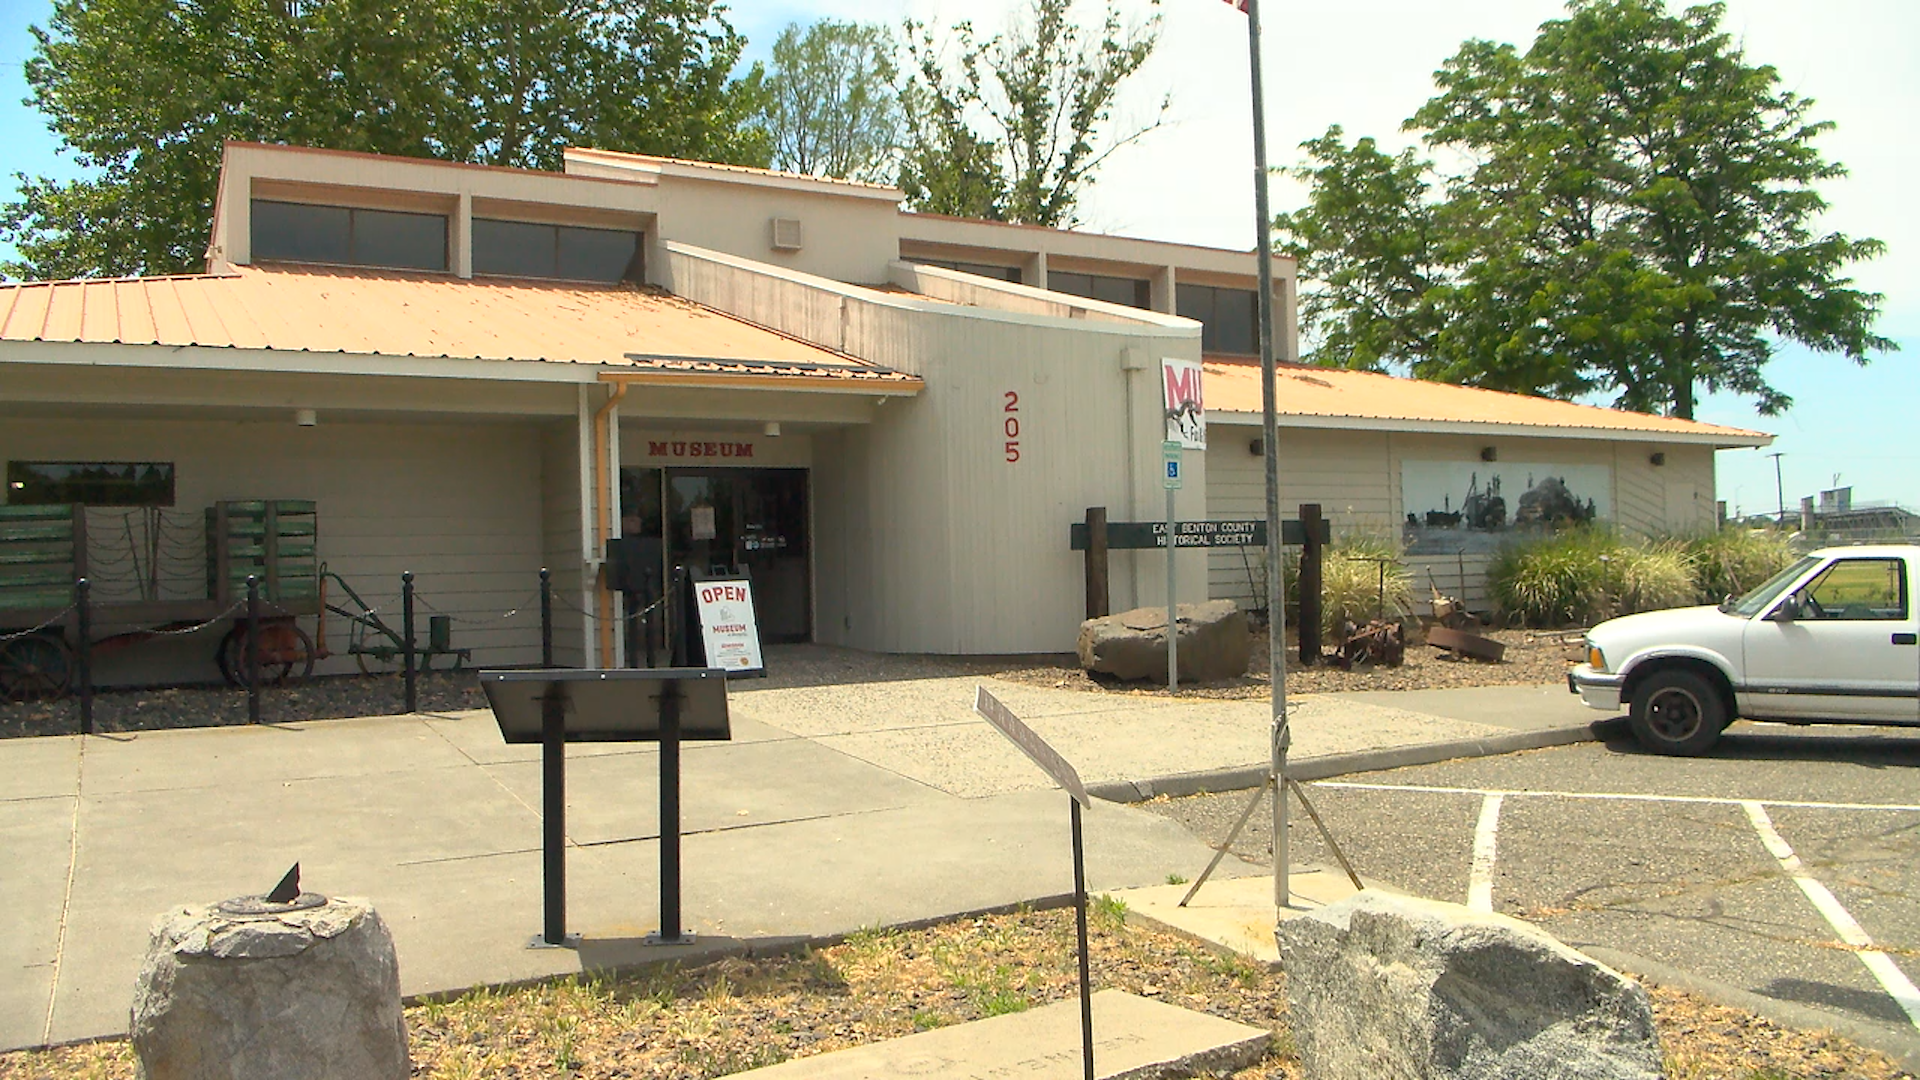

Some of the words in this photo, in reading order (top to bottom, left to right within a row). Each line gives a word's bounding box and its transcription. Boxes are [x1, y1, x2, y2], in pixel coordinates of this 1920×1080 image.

[1005, 391, 1020, 462] 205
[649, 441, 754, 457] MUSEUM
[1181, 523, 1218, 534] BENTON
[1221, 522, 1257, 533] COUNTY
[1157, 534, 1211, 546] HITORICAL
[1214, 534, 1254, 544] SOCIETY
[702, 586, 746, 604] OPEN
[712, 624, 747, 634] MUSEUM
